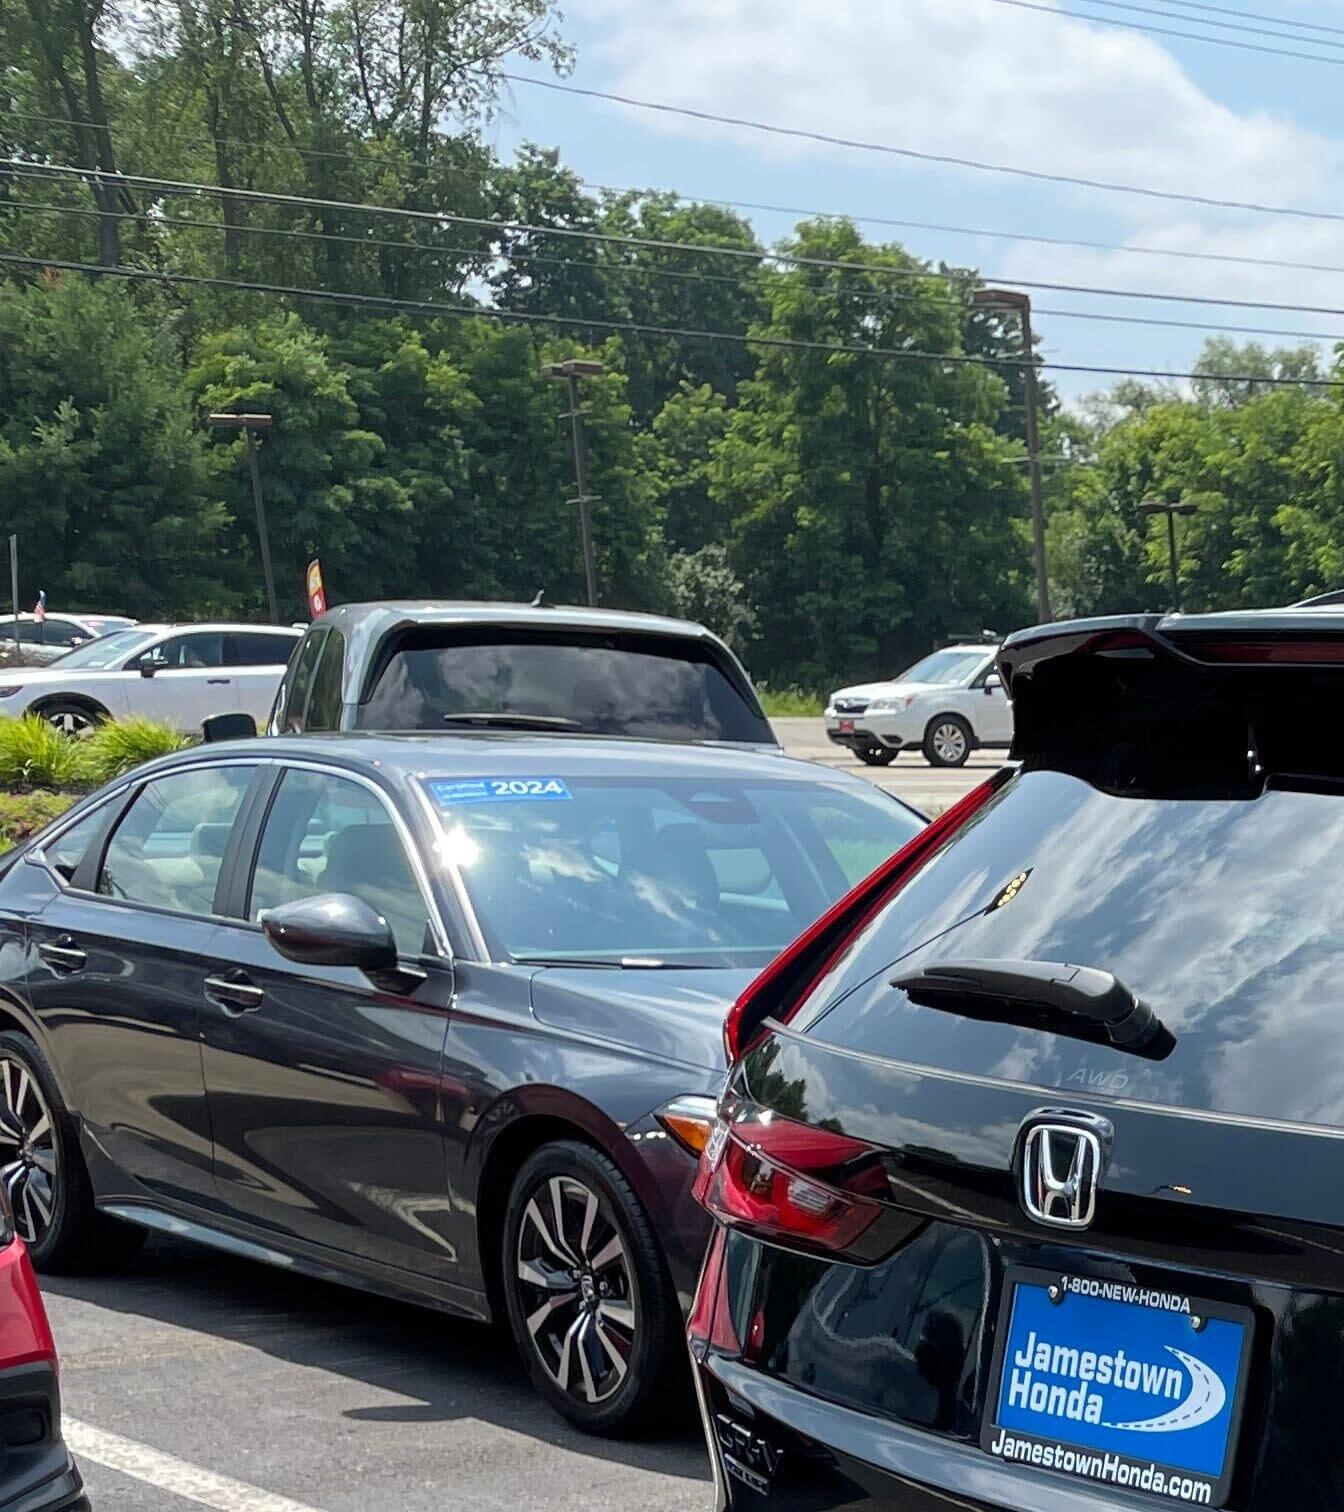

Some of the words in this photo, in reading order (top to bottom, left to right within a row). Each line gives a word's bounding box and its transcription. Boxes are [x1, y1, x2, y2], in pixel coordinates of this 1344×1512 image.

[490, 780, 563, 796] 2024
[1014, 1331, 1183, 1400] Jamestown
[1008, 1369, 1103, 1425] Honda
[991, 1430, 1212, 1504] JamestownHonda.com
